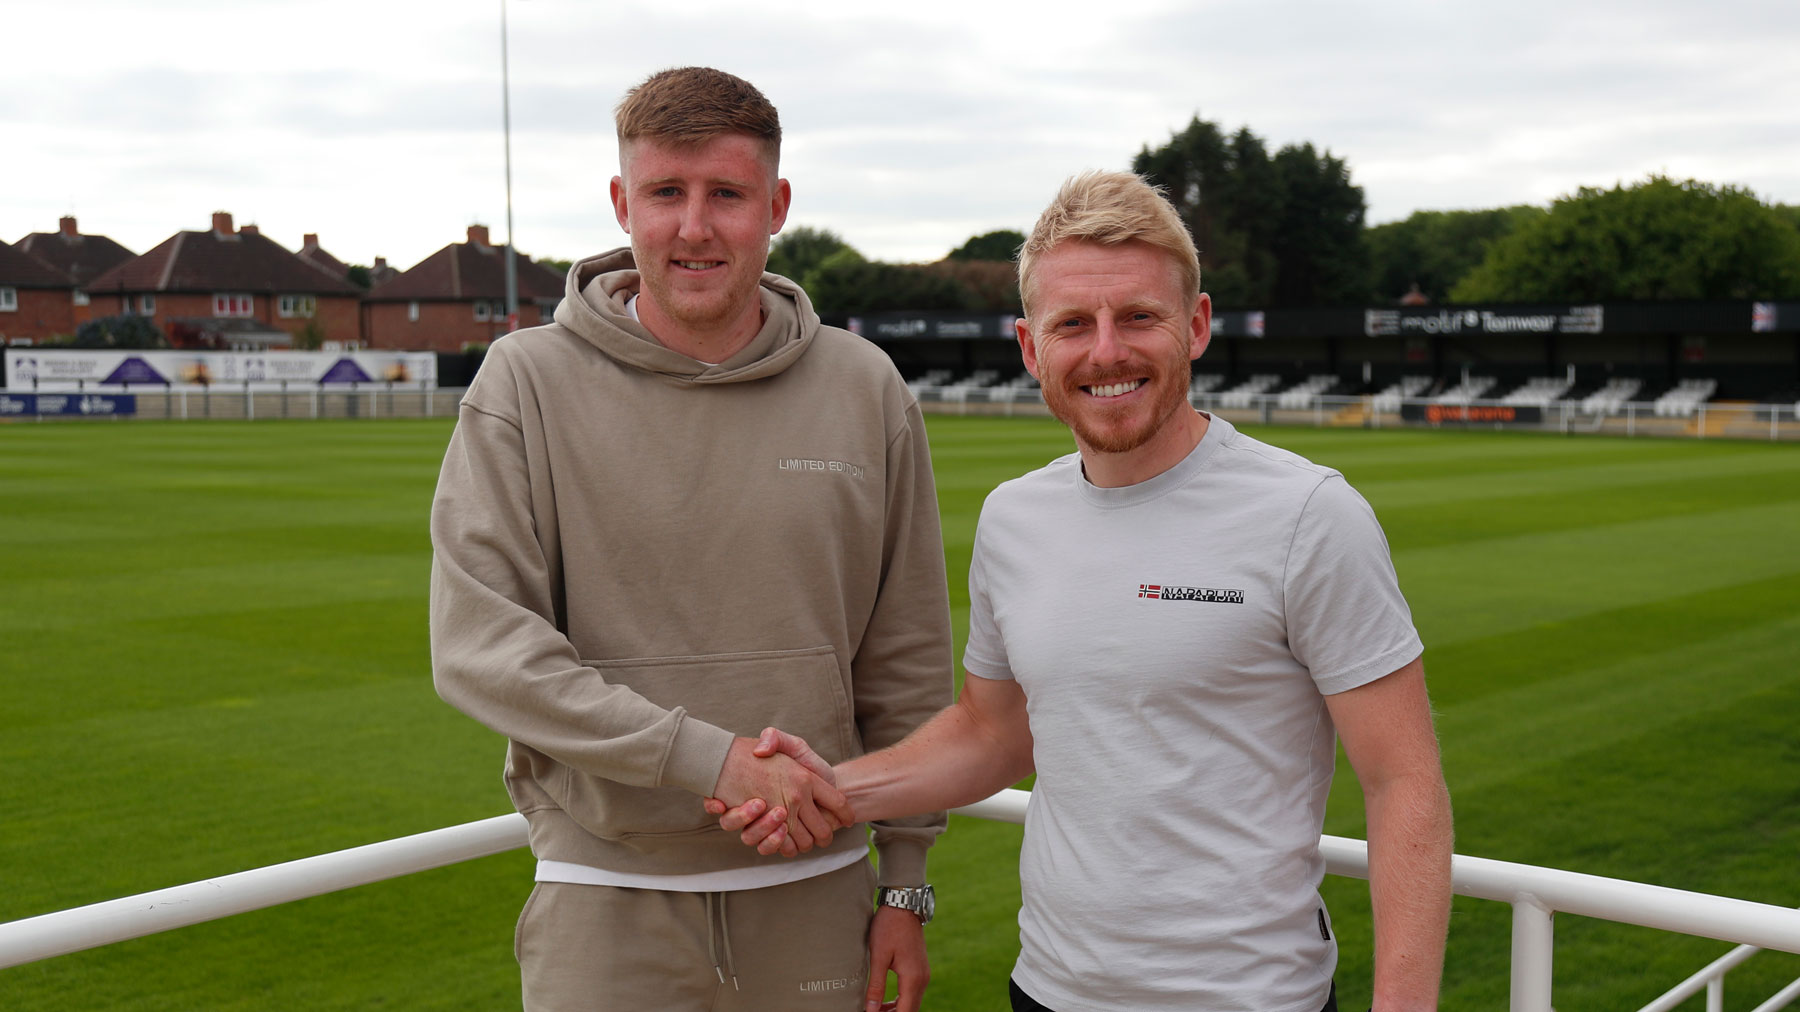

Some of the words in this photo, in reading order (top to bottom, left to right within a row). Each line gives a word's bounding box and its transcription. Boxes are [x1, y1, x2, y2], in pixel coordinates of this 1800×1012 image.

[1480, 311, 1556, 332] Teamwear
[779, 458, 825, 471] LIMITED
[828, 461, 865, 479] EDITION
[1162, 587, 1243, 603] NAPAPIJRI
[799, 978, 847, 992] LIMITED
